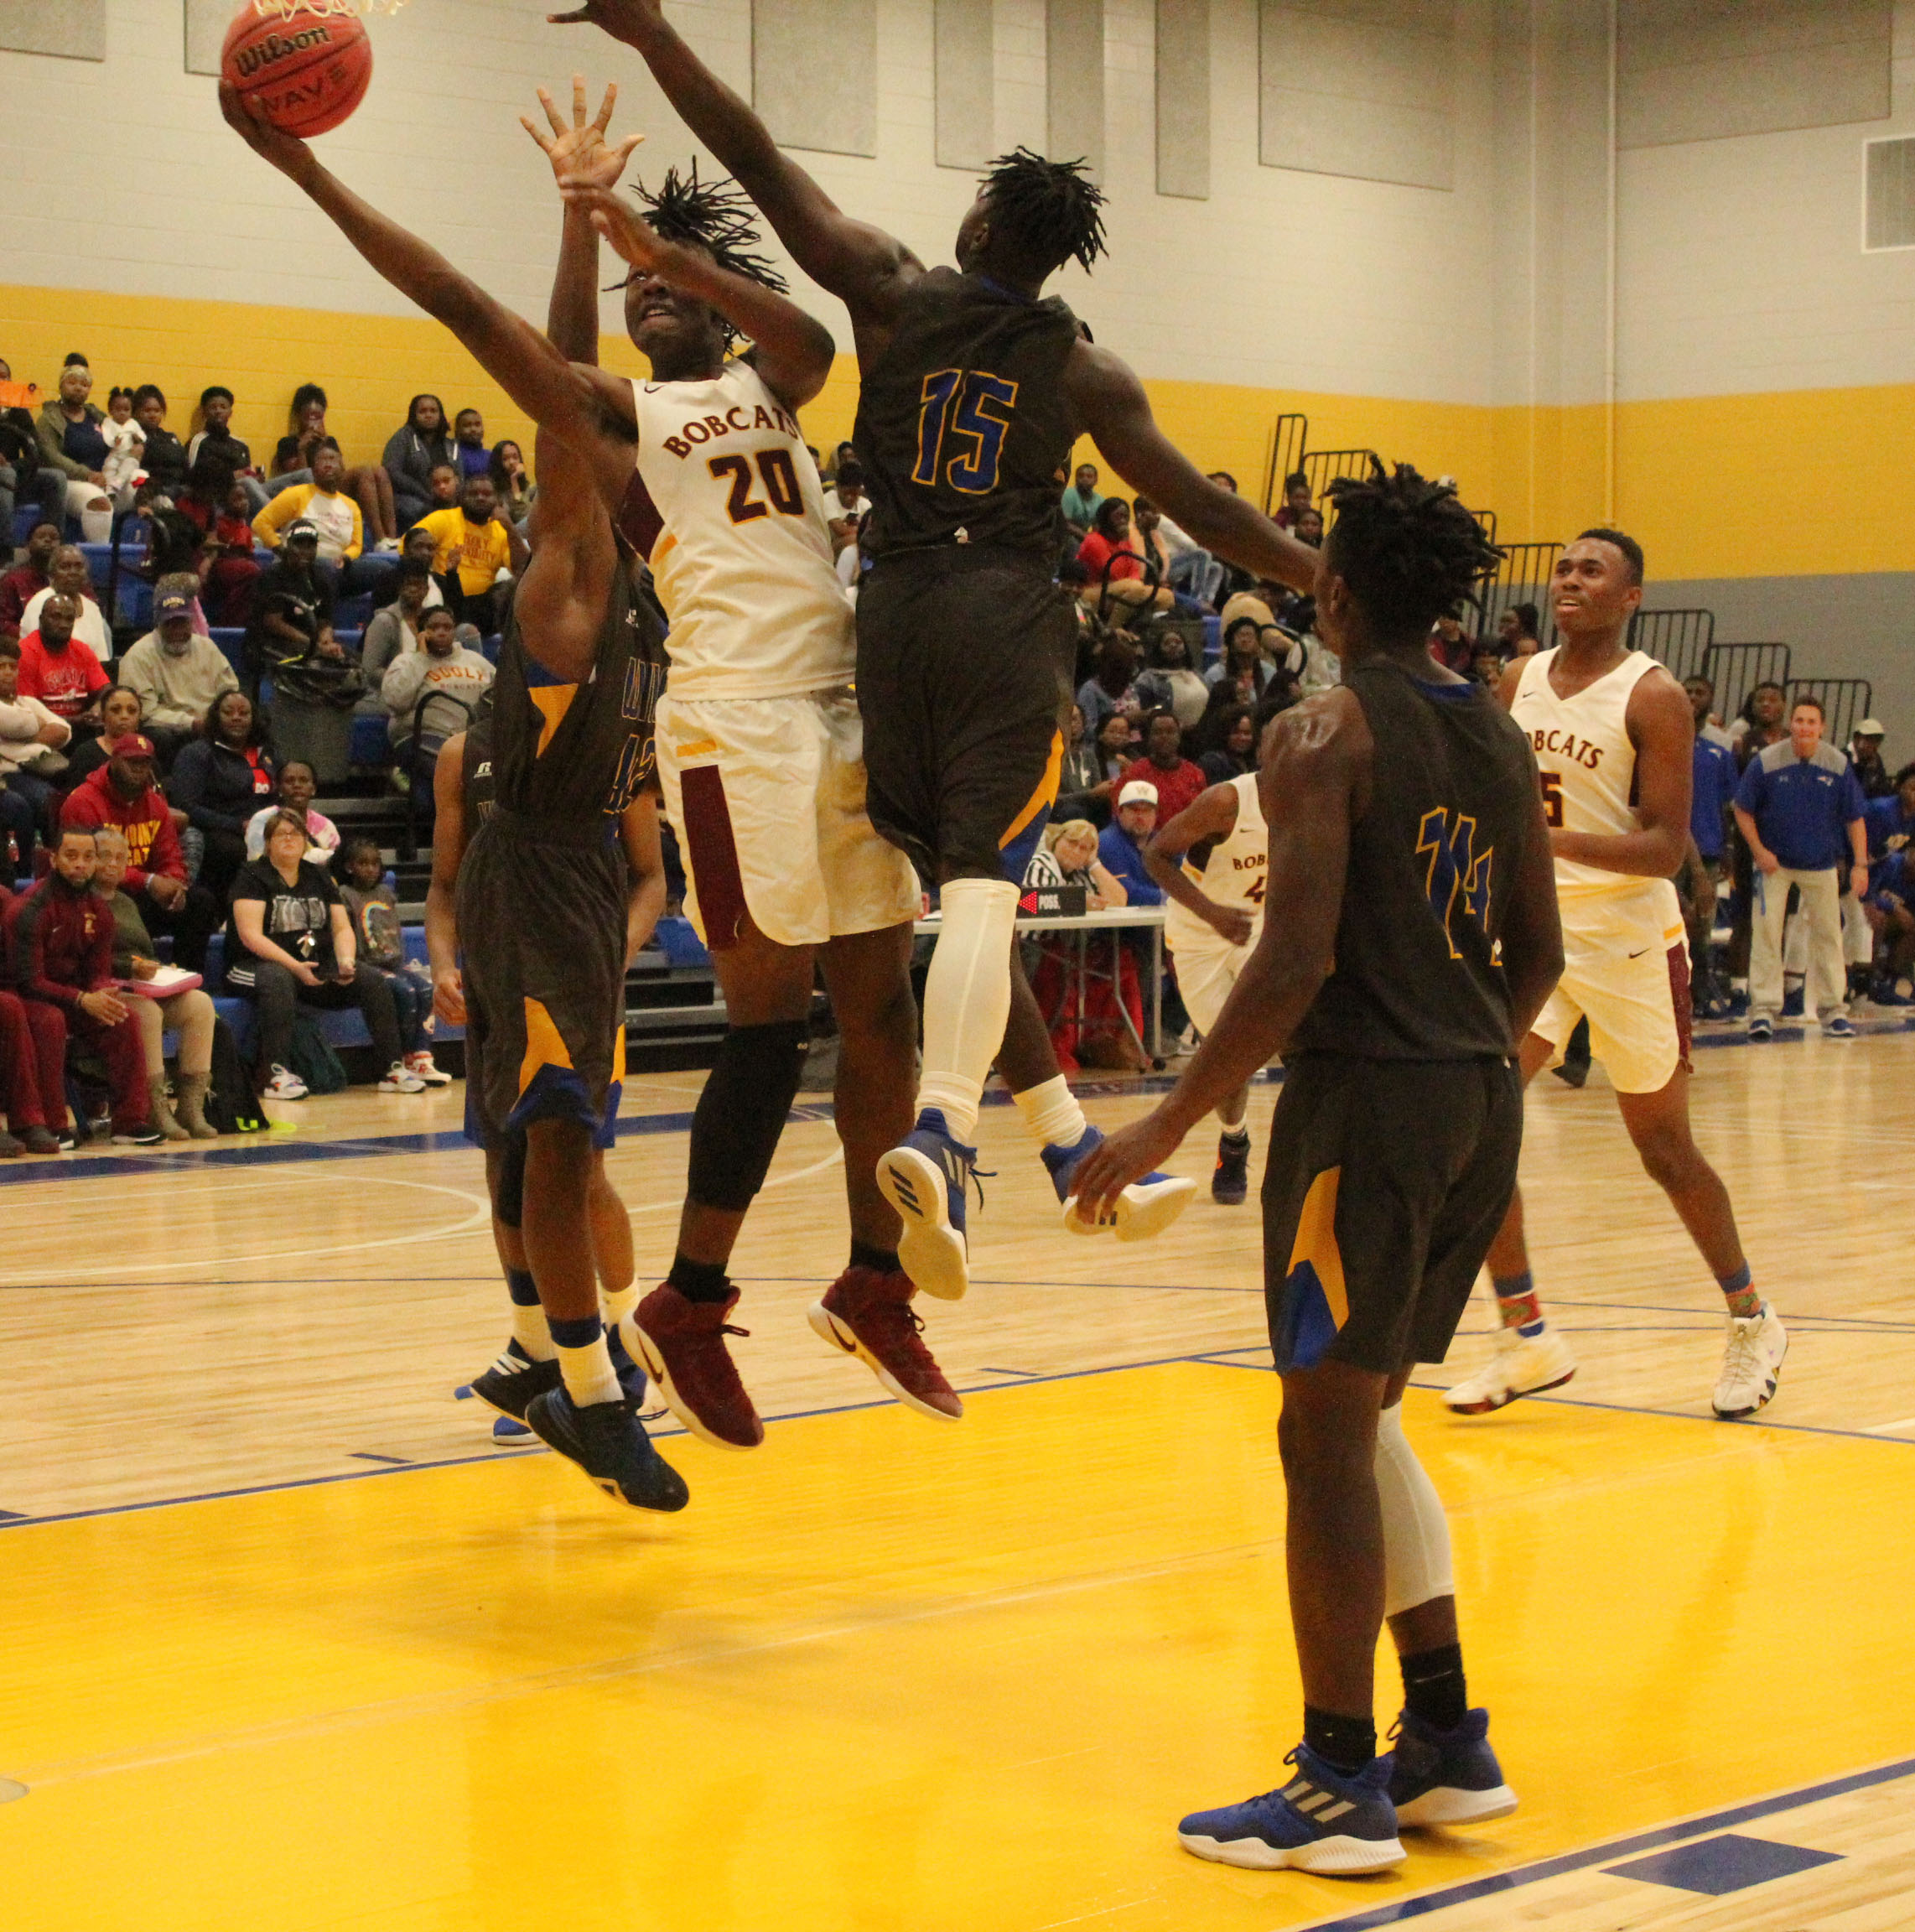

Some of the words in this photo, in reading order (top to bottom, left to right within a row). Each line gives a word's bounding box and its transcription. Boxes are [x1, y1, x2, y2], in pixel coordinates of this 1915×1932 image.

[236, 26, 332, 77] Wilson
[911, 367, 1020, 495] 15
[706, 448, 806, 527] 20
[1525, 730, 1605, 770] BCATS
[1233, 854, 1268, 870] BOB
